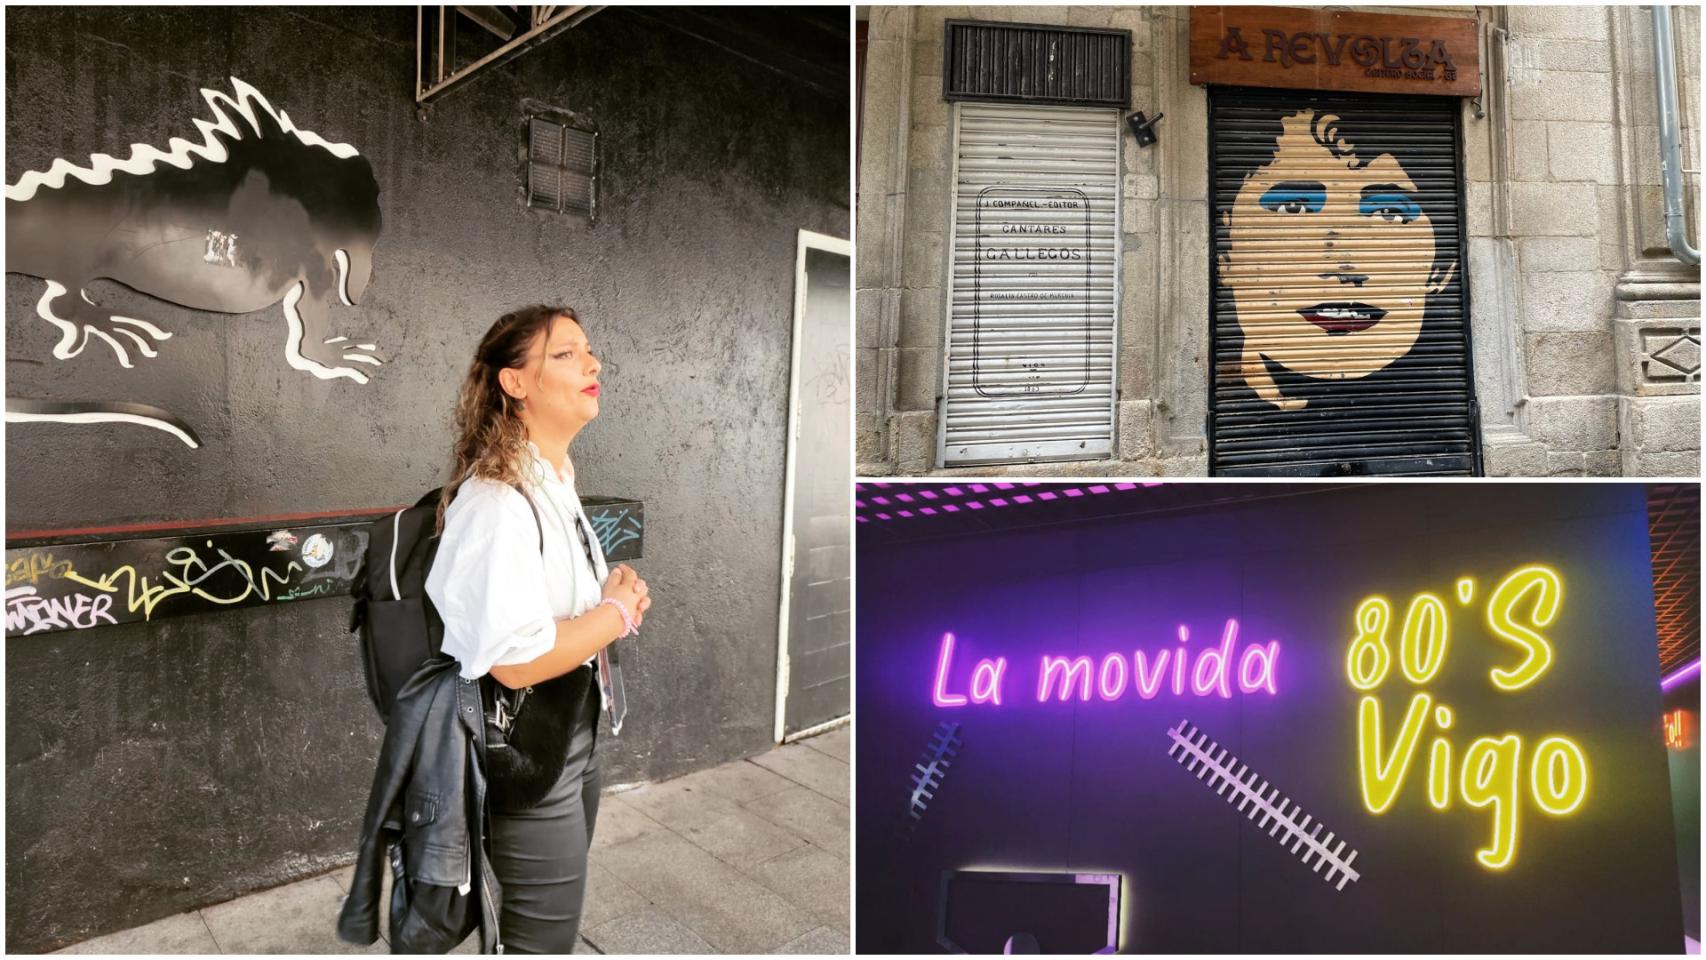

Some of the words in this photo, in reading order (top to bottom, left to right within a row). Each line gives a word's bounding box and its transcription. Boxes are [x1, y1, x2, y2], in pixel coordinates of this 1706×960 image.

[1216, 26, 1252, 62] A
[1002, 225, 1067, 234] CANTARES
[986, 247, 1081, 261] GALLEGOS
[934, 632, 1007, 707] La
[1036, 618, 1280, 703] movida
[1358, 693, 1588, 869] Vigo
